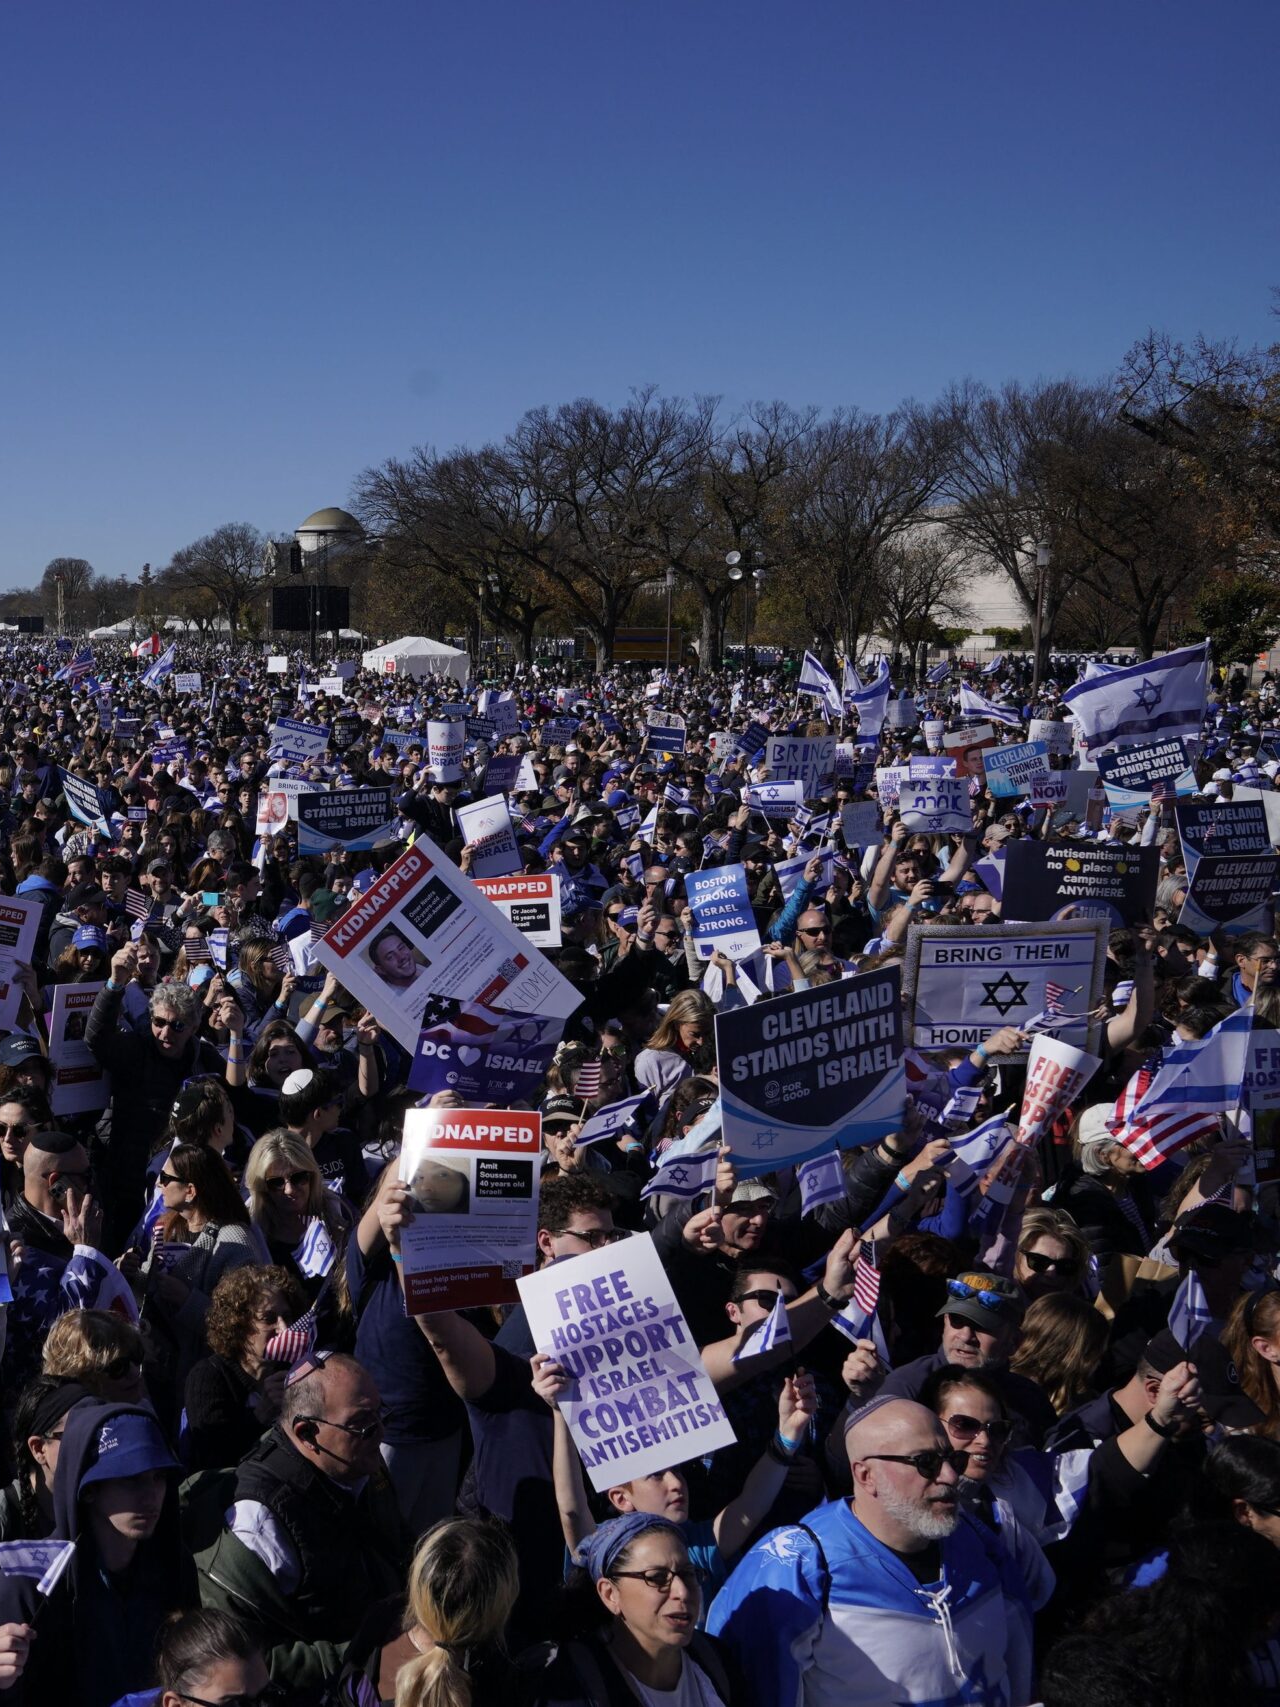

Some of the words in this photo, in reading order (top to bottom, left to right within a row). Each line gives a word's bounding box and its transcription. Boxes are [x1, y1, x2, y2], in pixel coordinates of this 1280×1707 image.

[284, 721, 323, 735] CHATTANOOGA
[274, 734, 294, 743] STANDS
[308, 741, 323, 750] WITH
[387, 735, 420, 744] CLEVELAND
[431, 743, 463, 752] AMERICA
[287, 752, 305, 761] ISRAEL
[772, 741, 833, 763] BRING
[989, 744, 1037, 768] CLEVELAND
[1116, 741, 1181, 766] CLEVELAND
[772, 762, 828, 782] THEM
[1006, 757, 1044, 777] STRONGER
[1105, 760, 1152, 780] STANDS
[1151, 752, 1184, 768] WITH
[1146, 763, 1188, 780] ISRAEL
[884, 772, 902, 780] FREE
[1009, 774, 1030, 788] THAN
[62, 780, 84, 799] STANDS
[66, 774, 97, 798] CLEVELAND
[278, 782, 298, 790] BRING
[300, 783, 319, 791] THEM
[1033, 785, 1068, 799] NOW
[319, 792, 387, 807] CLEVELAND
[912, 795, 962, 811] אחרת
[304, 806, 352, 819] STANDS
[354, 804, 387, 815] WITH
[1198, 806, 1262, 823] CLEVELAND
[345, 815, 387, 828] ISRAEL
[1233, 822, 1265, 834] WITH
[472, 830, 510, 847] AMERICA
[496, 836, 512, 844] WITH
[1227, 836, 1268, 851] ISRAEL
[1045, 847, 1124, 861] Antisemitism
[1125, 851, 1141, 862] has
[1047, 861, 1063, 870] no
[1082, 862, 1113, 874] place
[1129, 866, 1140, 874] on
[1215, 861, 1278, 876] CLEVELAND
[477, 881, 548, 895] DNAPPED
[695, 874, 736, 891] BOSTON
[1063, 875, 1109, 886] campus
[1195, 878, 1241, 892] STANDS
[1241, 876, 1273, 889] WITH
[695, 888, 740, 904] STRONG.
[1056, 885, 1127, 898] ANYWHERE.
[1227, 891, 1267, 905] ISRAEL
[332, 855, 422, 948] KIDNAPPED
[700, 903, 739, 917] ISRAEL
[699, 917, 748, 932] STRONG.
[935, 946, 1002, 963] BRING
[1013, 943, 1070, 960] THEM
[513, 961, 556, 1009] HOME
[483, 988, 498, 1006] them
[762, 982, 894, 1041] CLEVELAND
[931, 1029, 992, 1044] HOME
[731, 1031, 830, 1082] STANDS
[832, 1012, 895, 1053] WITH
[421, 1041, 452, 1060] DC
[485, 1053, 546, 1074] ISRAEL
[817, 1043, 899, 1089] ISRAEL
[1032, 1056, 1085, 1094] FREE
[782, 1081, 802, 1094] FOR
[782, 1087, 811, 1103] GOOD
[432, 1124, 534, 1144] DNAPPED
[480, 1162, 498, 1170] Amit
[479, 1171, 517, 1179] Soussana
[411, 1278, 433, 1286] Please
[450, 1273, 469, 1281] bring
[412, 1288, 430, 1296] home
[555, 1270, 634, 1321] FREE
[551, 1296, 660, 1351] HOSTAGES
[589, 1358, 668, 1399] ISRAEL
[578, 1370, 702, 1440] COMBAT
[580, 1402, 730, 1470] ANTISEMITISM
